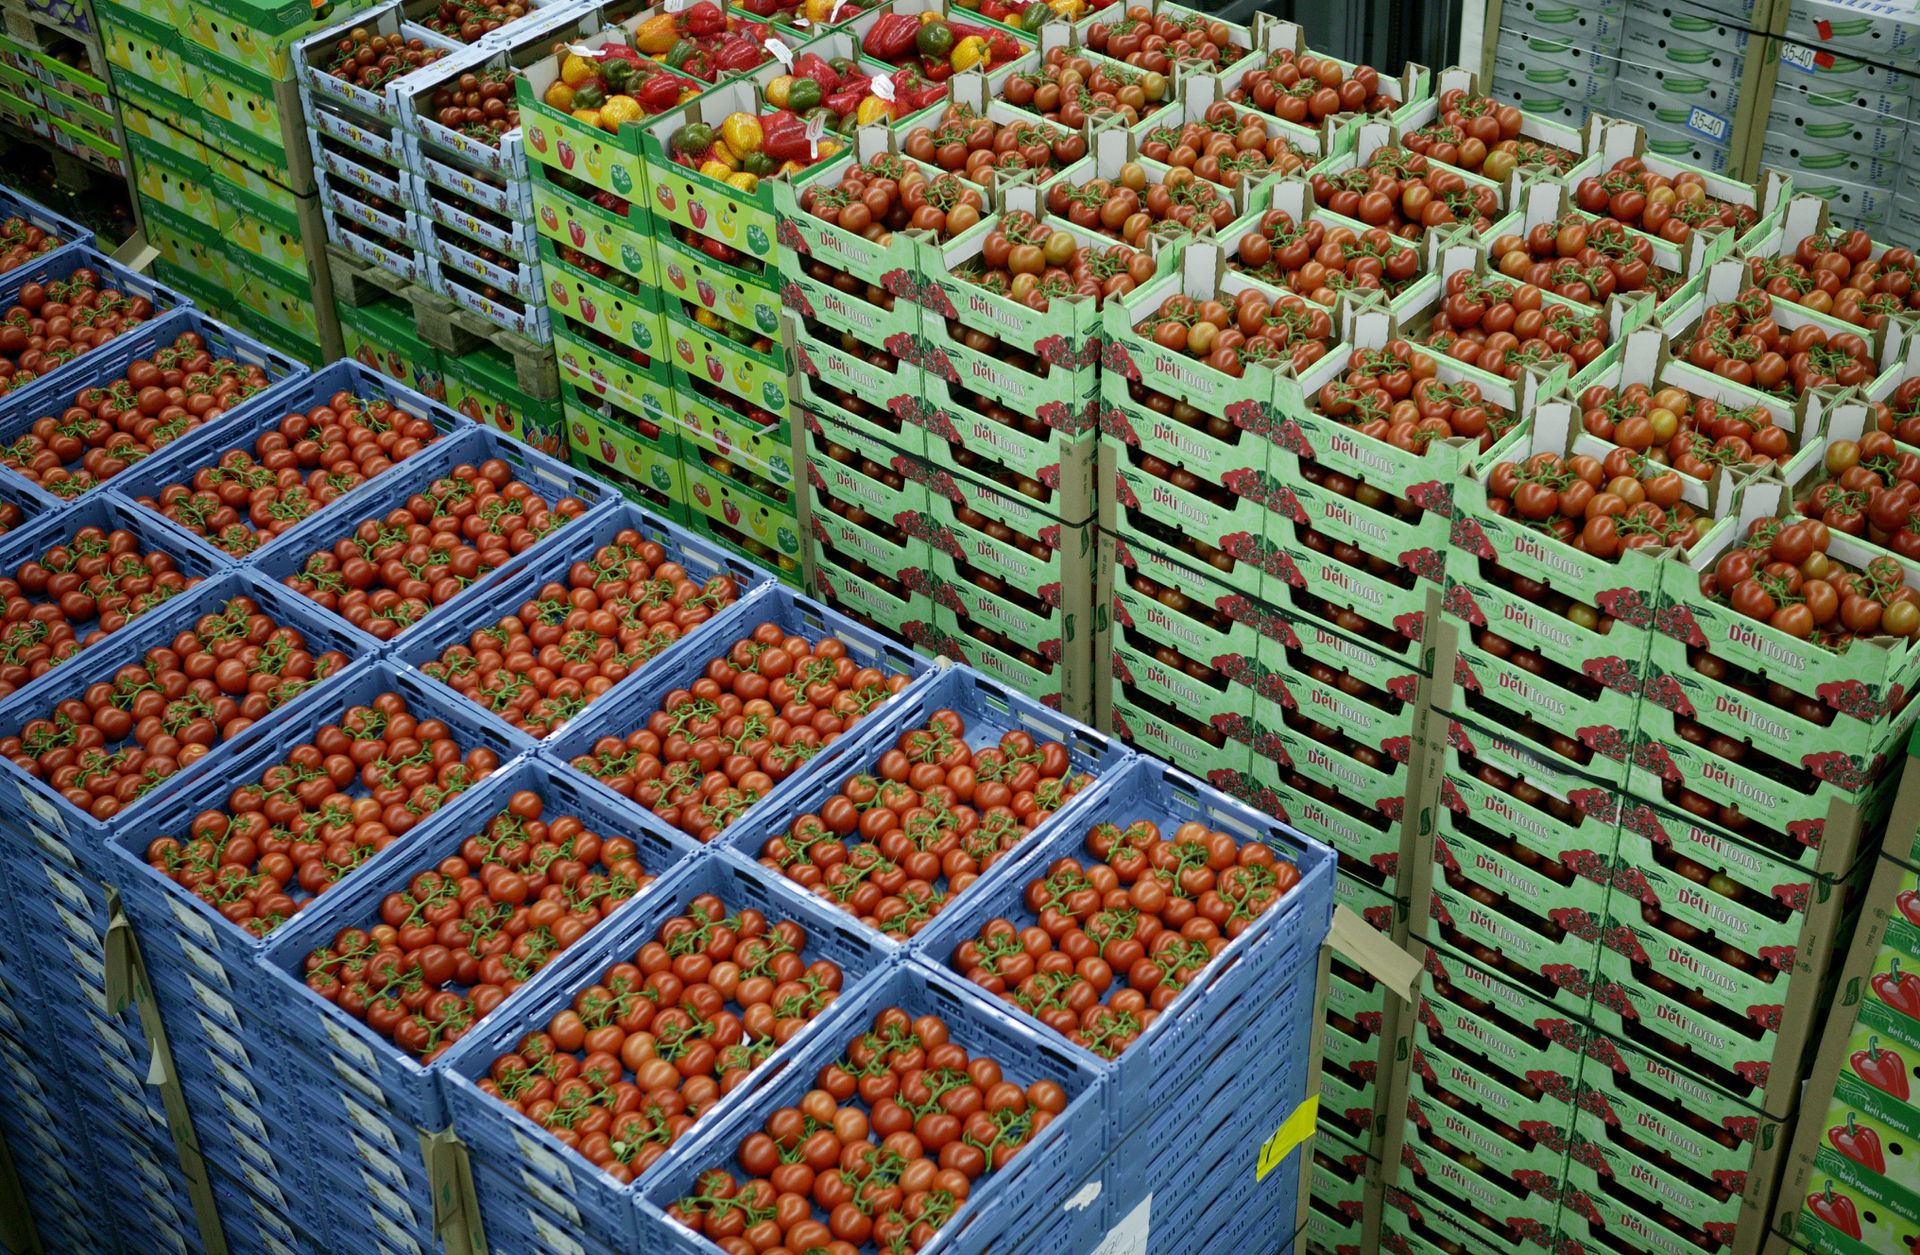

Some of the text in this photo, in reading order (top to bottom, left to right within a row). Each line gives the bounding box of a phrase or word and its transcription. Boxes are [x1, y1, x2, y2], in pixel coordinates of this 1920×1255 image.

[1782, 42, 1811, 68] 35-40
[1691, 111, 1722, 136] 35-40
[1864, 1104, 1910, 1133] Bell Peppers
